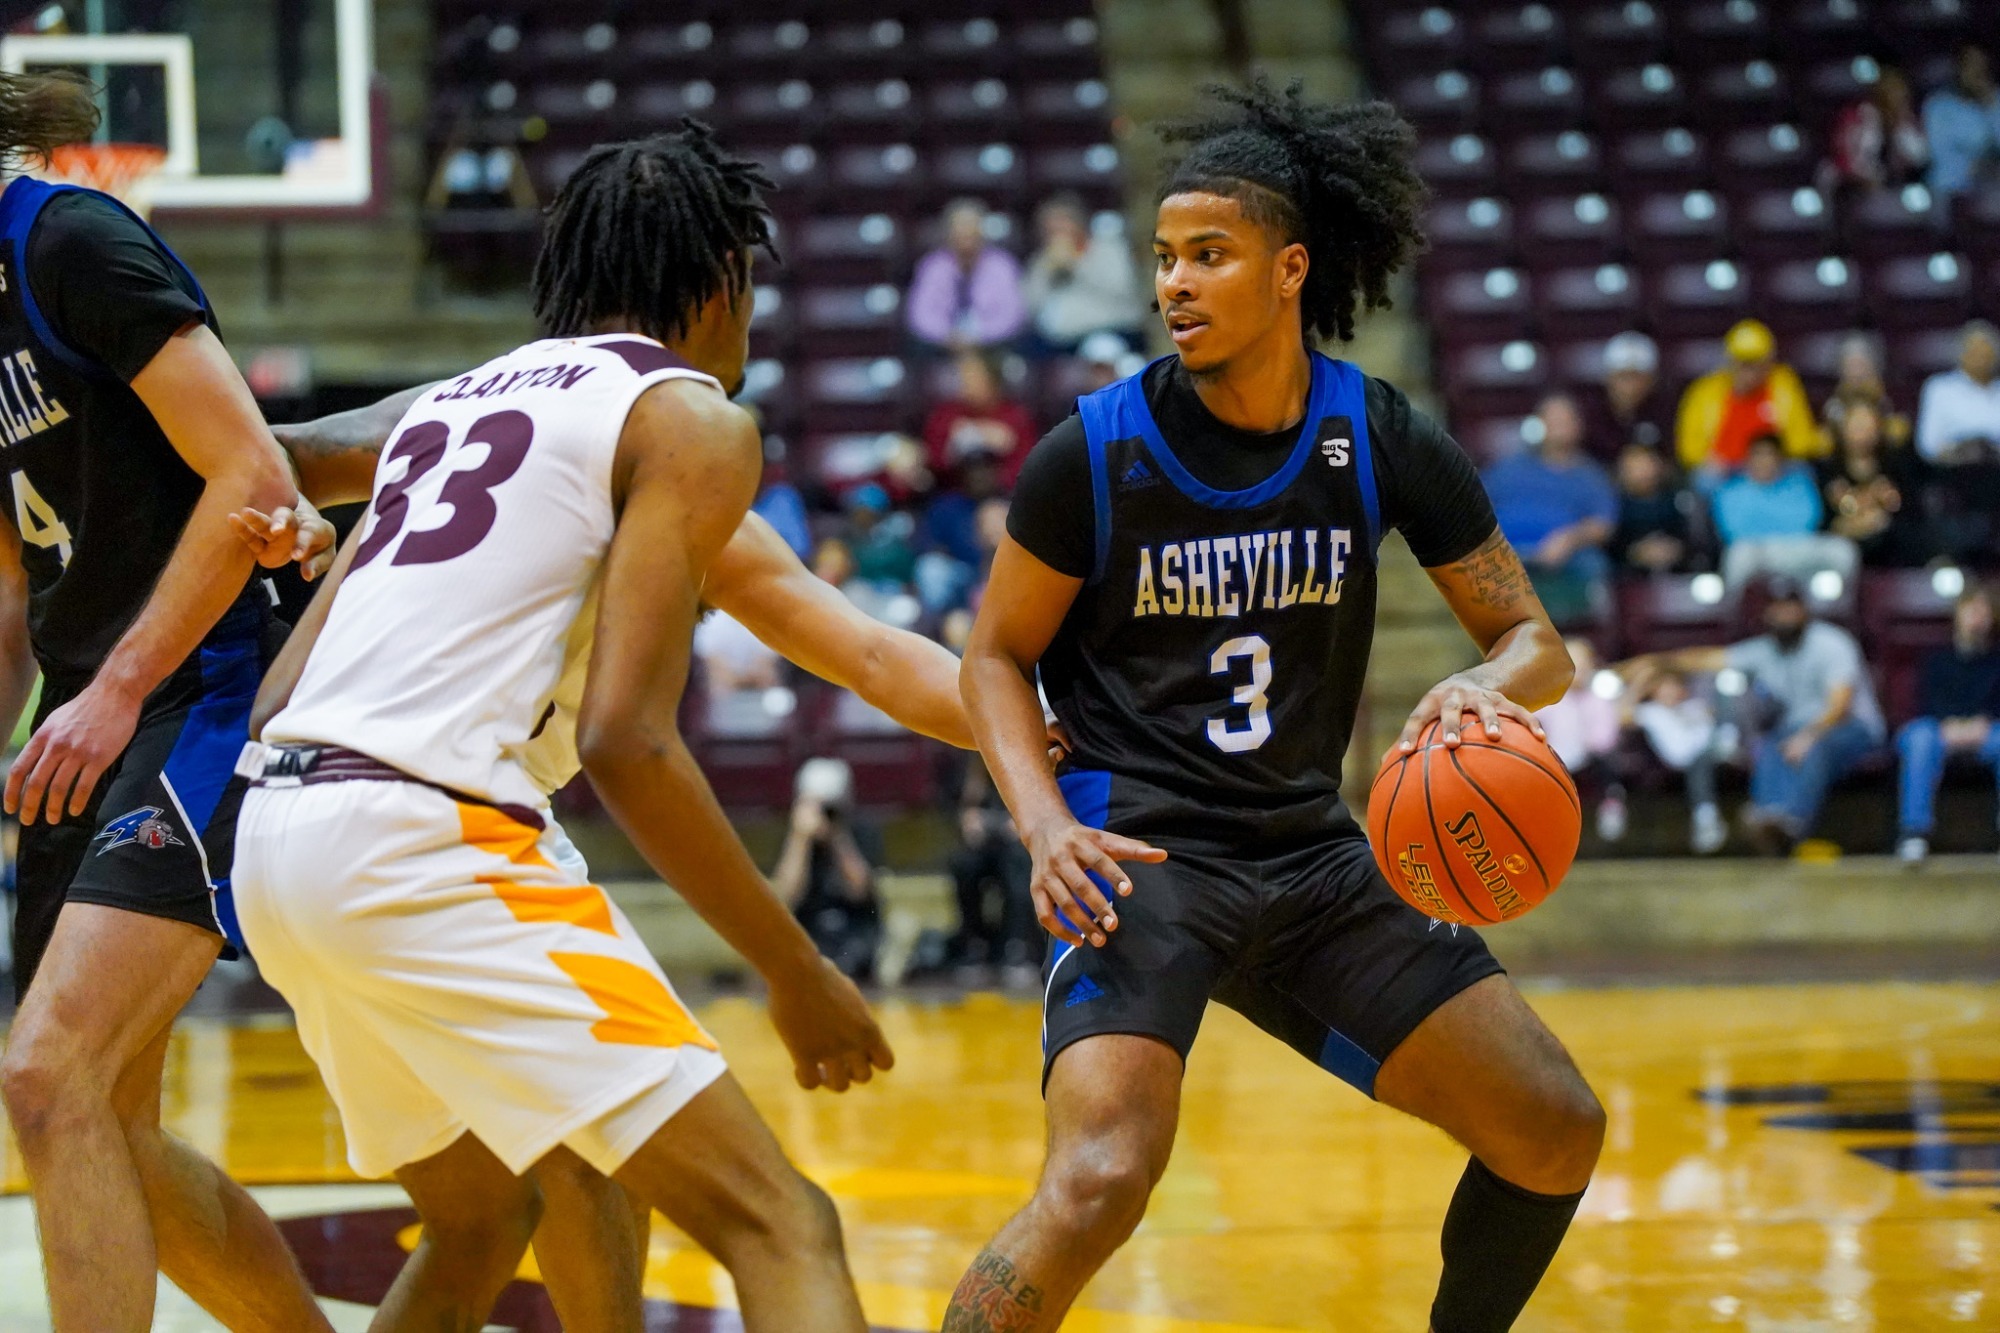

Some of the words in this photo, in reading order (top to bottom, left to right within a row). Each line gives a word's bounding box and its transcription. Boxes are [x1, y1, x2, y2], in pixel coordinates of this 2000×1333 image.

[10, 469, 73, 570] 4
[342, 409, 534, 584] 33
[1133, 527, 1352, 618] ASHEVILLE
[1206, 633, 1273, 754] 3
[1407, 842, 1468, 925] LEGAC
